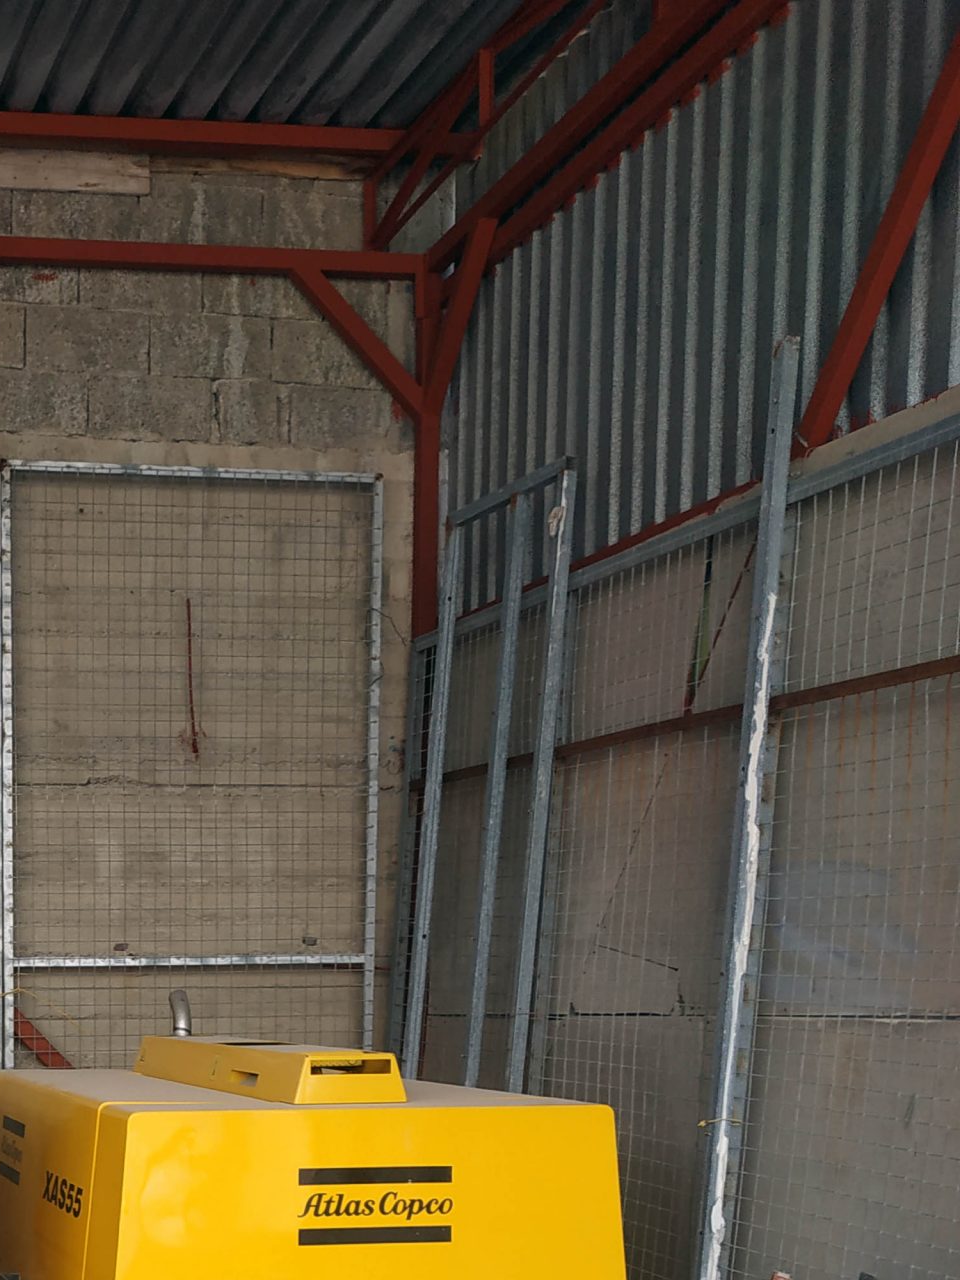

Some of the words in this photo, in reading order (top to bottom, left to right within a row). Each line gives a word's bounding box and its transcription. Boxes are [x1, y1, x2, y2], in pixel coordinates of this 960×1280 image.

[42, 1170, 83, 1218] XAS55
[297, 1193, 376, 1218] Atlas
[378, 1191, 454, 1220] Copco
